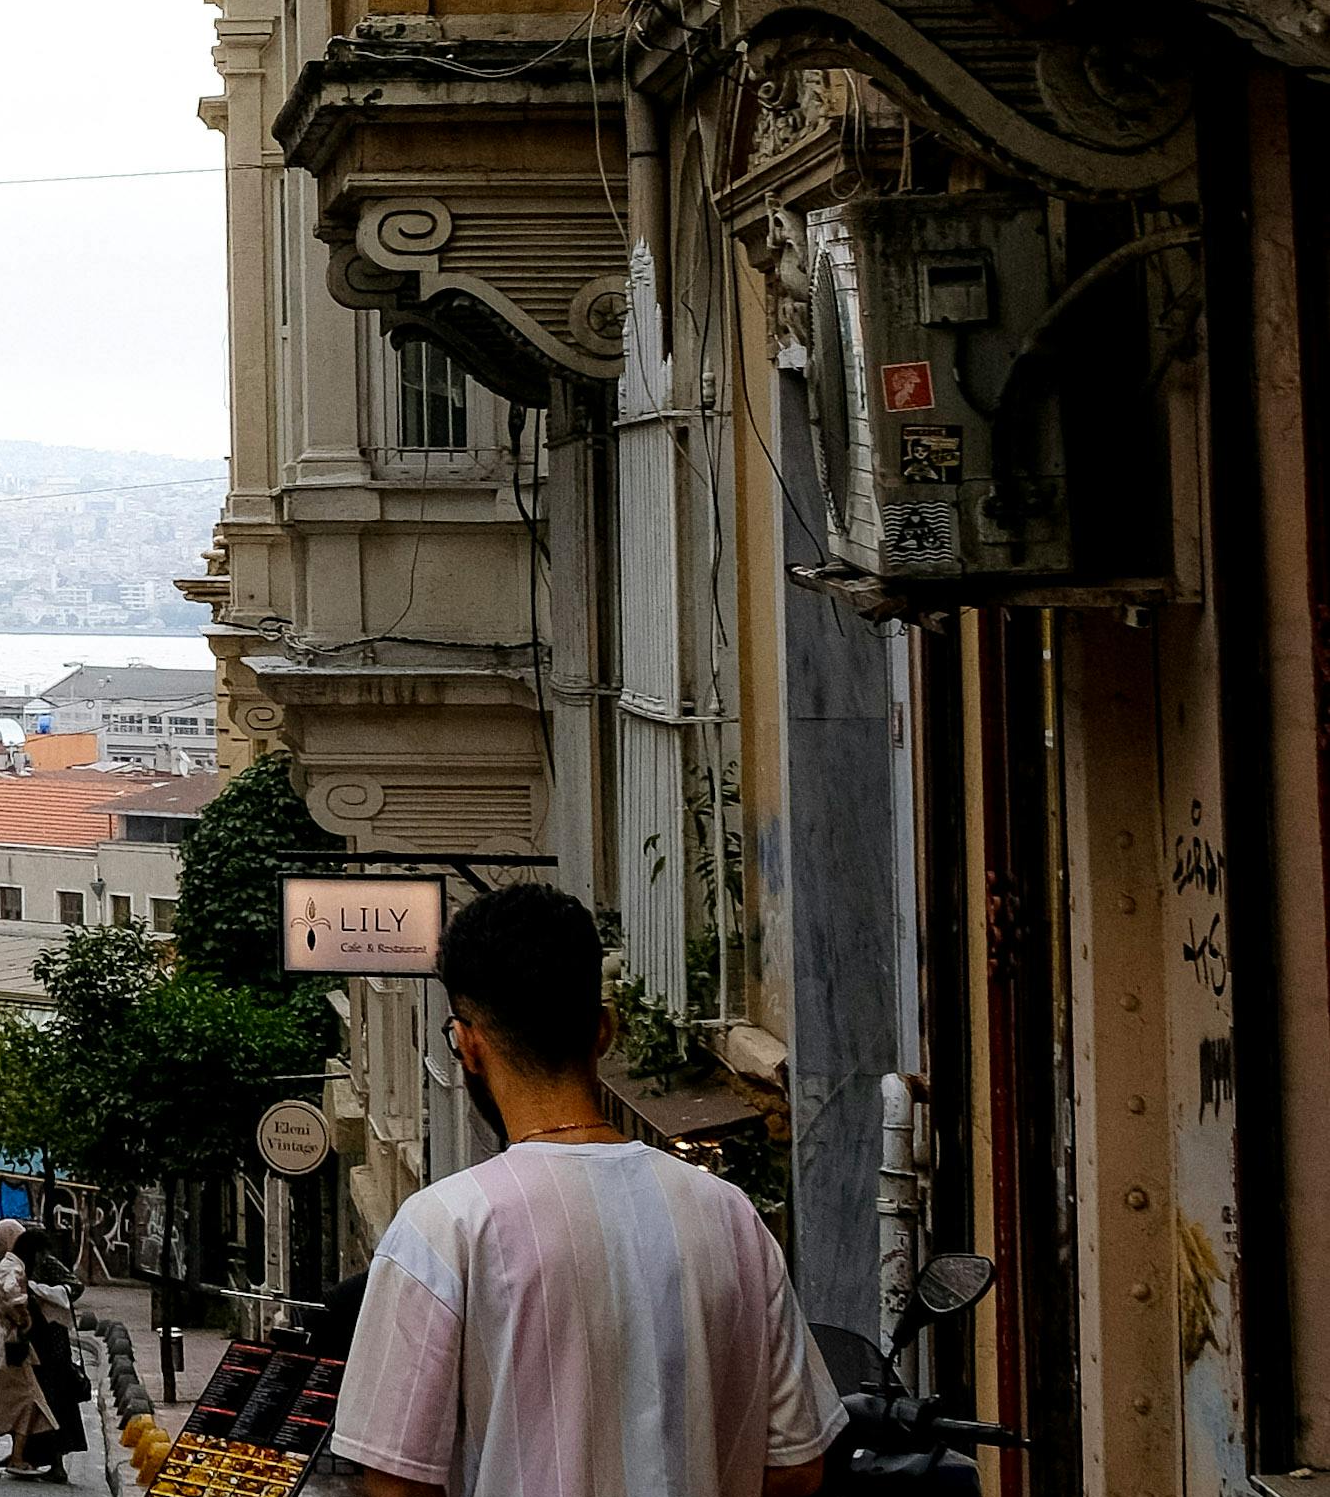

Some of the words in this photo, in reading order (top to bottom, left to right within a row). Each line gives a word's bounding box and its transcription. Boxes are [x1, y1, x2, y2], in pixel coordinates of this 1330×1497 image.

[341, 907, 409, 932] LILY
[367, 943, 374, 953] &
[275, 1121, 310, 1135] Eleni
[267, 1136, 319, 1155] Vintage
